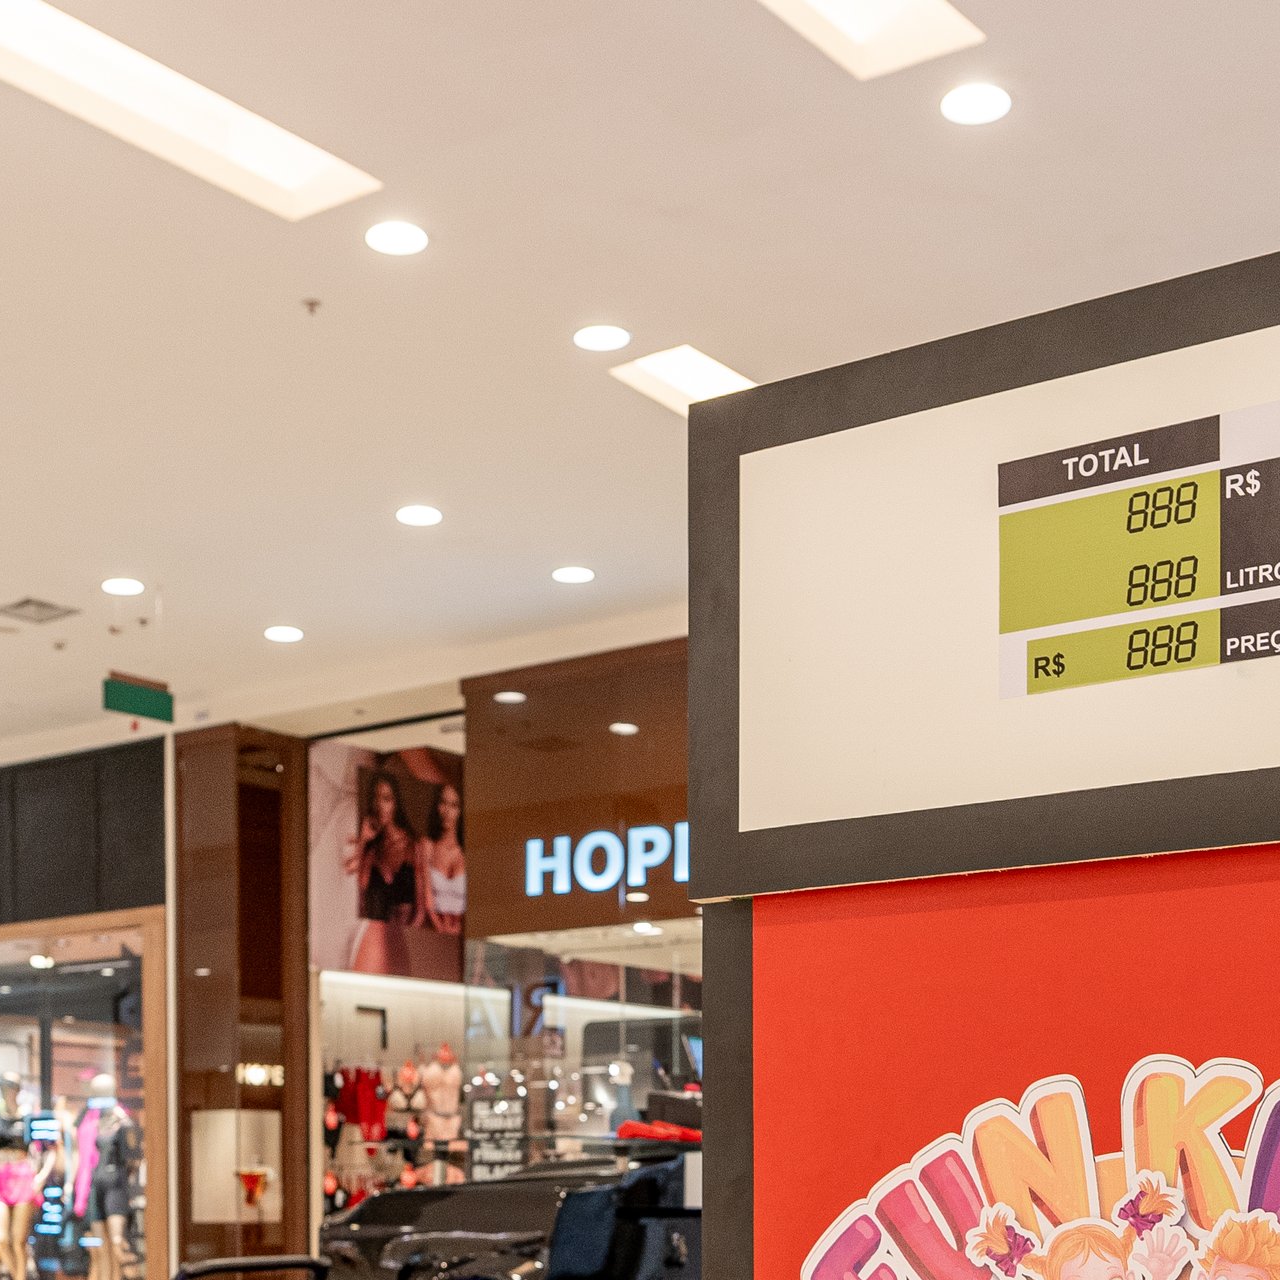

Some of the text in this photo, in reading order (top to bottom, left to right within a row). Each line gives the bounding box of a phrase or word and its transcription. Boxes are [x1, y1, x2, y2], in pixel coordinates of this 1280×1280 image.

[1062, 443, 1150, 481] TOTAL
[1126, 468, 1261, 534] 888 R$
[1126, 555, 1198, 607] 888
[1033, 652, 1066, 680] R$
[1126, 620, 1198, 671] 888
